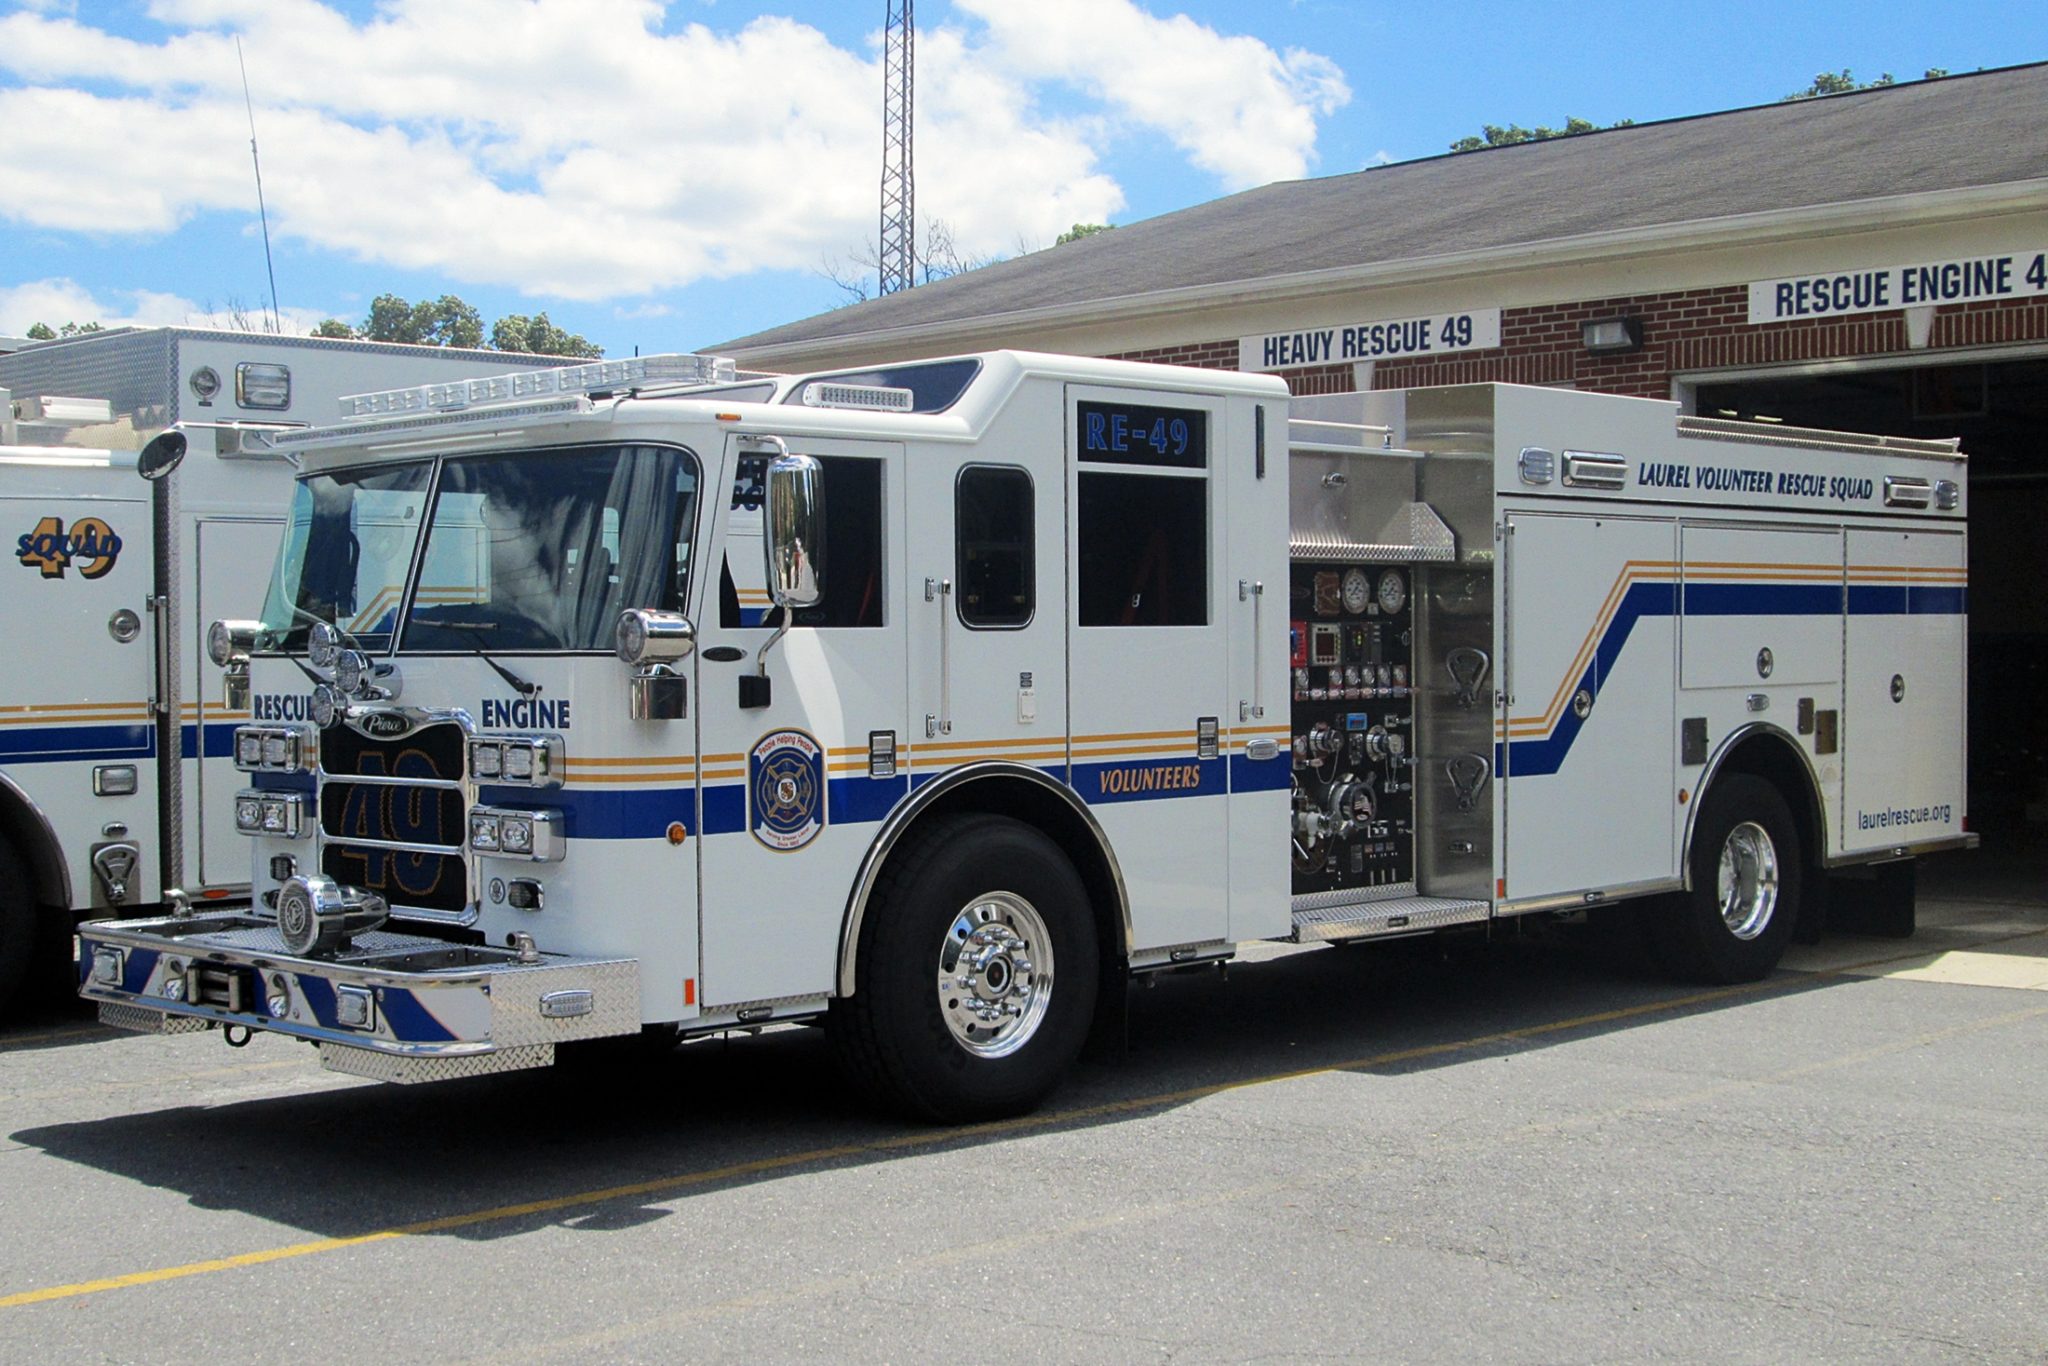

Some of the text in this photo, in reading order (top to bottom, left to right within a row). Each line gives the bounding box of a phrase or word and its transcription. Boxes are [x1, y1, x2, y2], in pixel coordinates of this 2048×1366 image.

[1776, 270, 1890, 317] RESCUE
[1902, 257, 2012, 303] ENGINE
[1264, 315, 1472, 367] HEAVY RESCUE 49
[1086, 412, 1188, 455] RE-49
[1638, 462, 1873, 502] LAUREL VOLUNTEER RESCUE SQUAD
[15, 533, 122, 560] SQUAD
[19, 517, 118, 579] 49
[368, 713, 401, 736] Pierce
[482, 699, 570, 729] ENGINE
[758, 734, 814, 756] People Helping People
[1100, 764, 1200, 793] VOLUNTEERS
[340, 748, 444, 895] 49
[1858, 804, 1951, 830] laurelrescue.org
